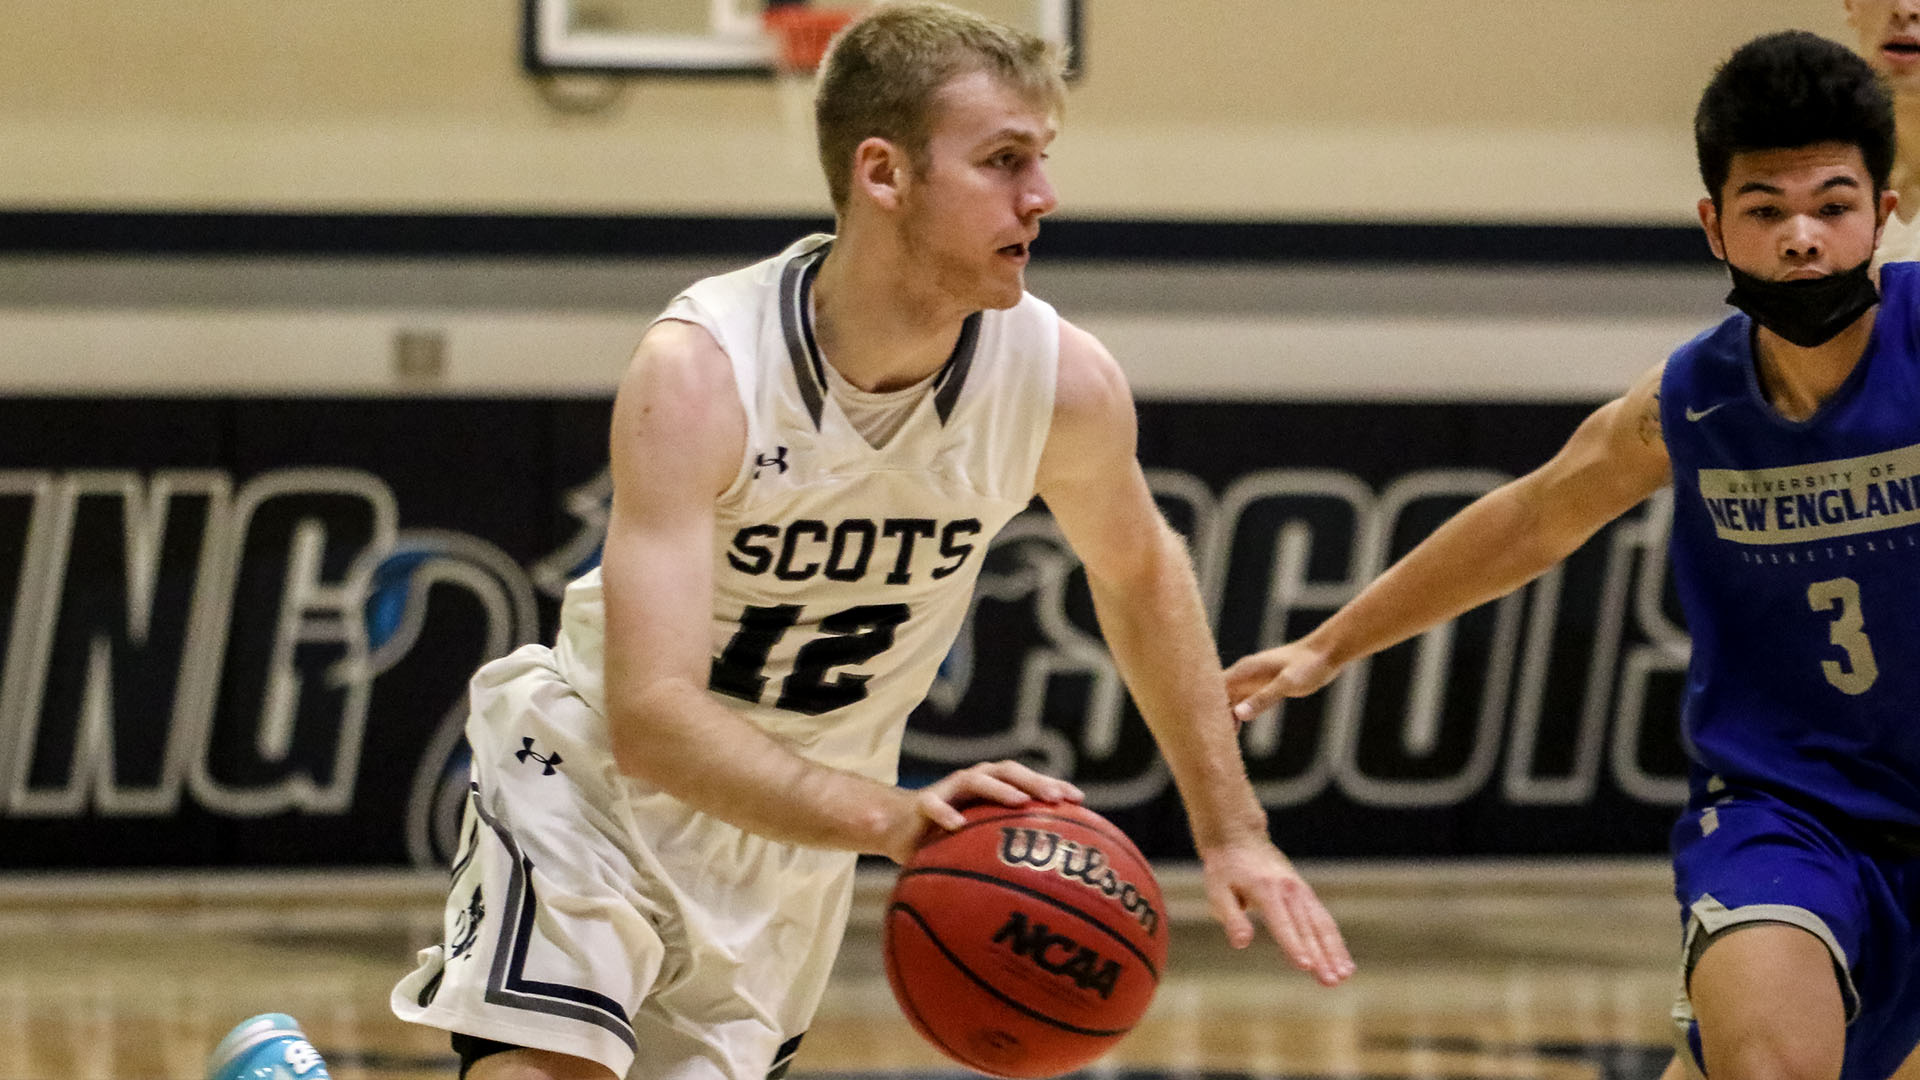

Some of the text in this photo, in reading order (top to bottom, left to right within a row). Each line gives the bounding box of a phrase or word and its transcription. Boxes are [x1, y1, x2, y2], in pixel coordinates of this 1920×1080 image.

[1707, 498, 1767, 532] NEW
[1728, 463, 1897, 494] UNIVERSITY OF
[726, 517, 982, 586] SCOTS
[708, 602, 911, 717] 12
[1807, 576, 1880, 696] 3
[998, 826, 1160, 938] Wilson
[991, 910, 1122, 1001] NCAA
